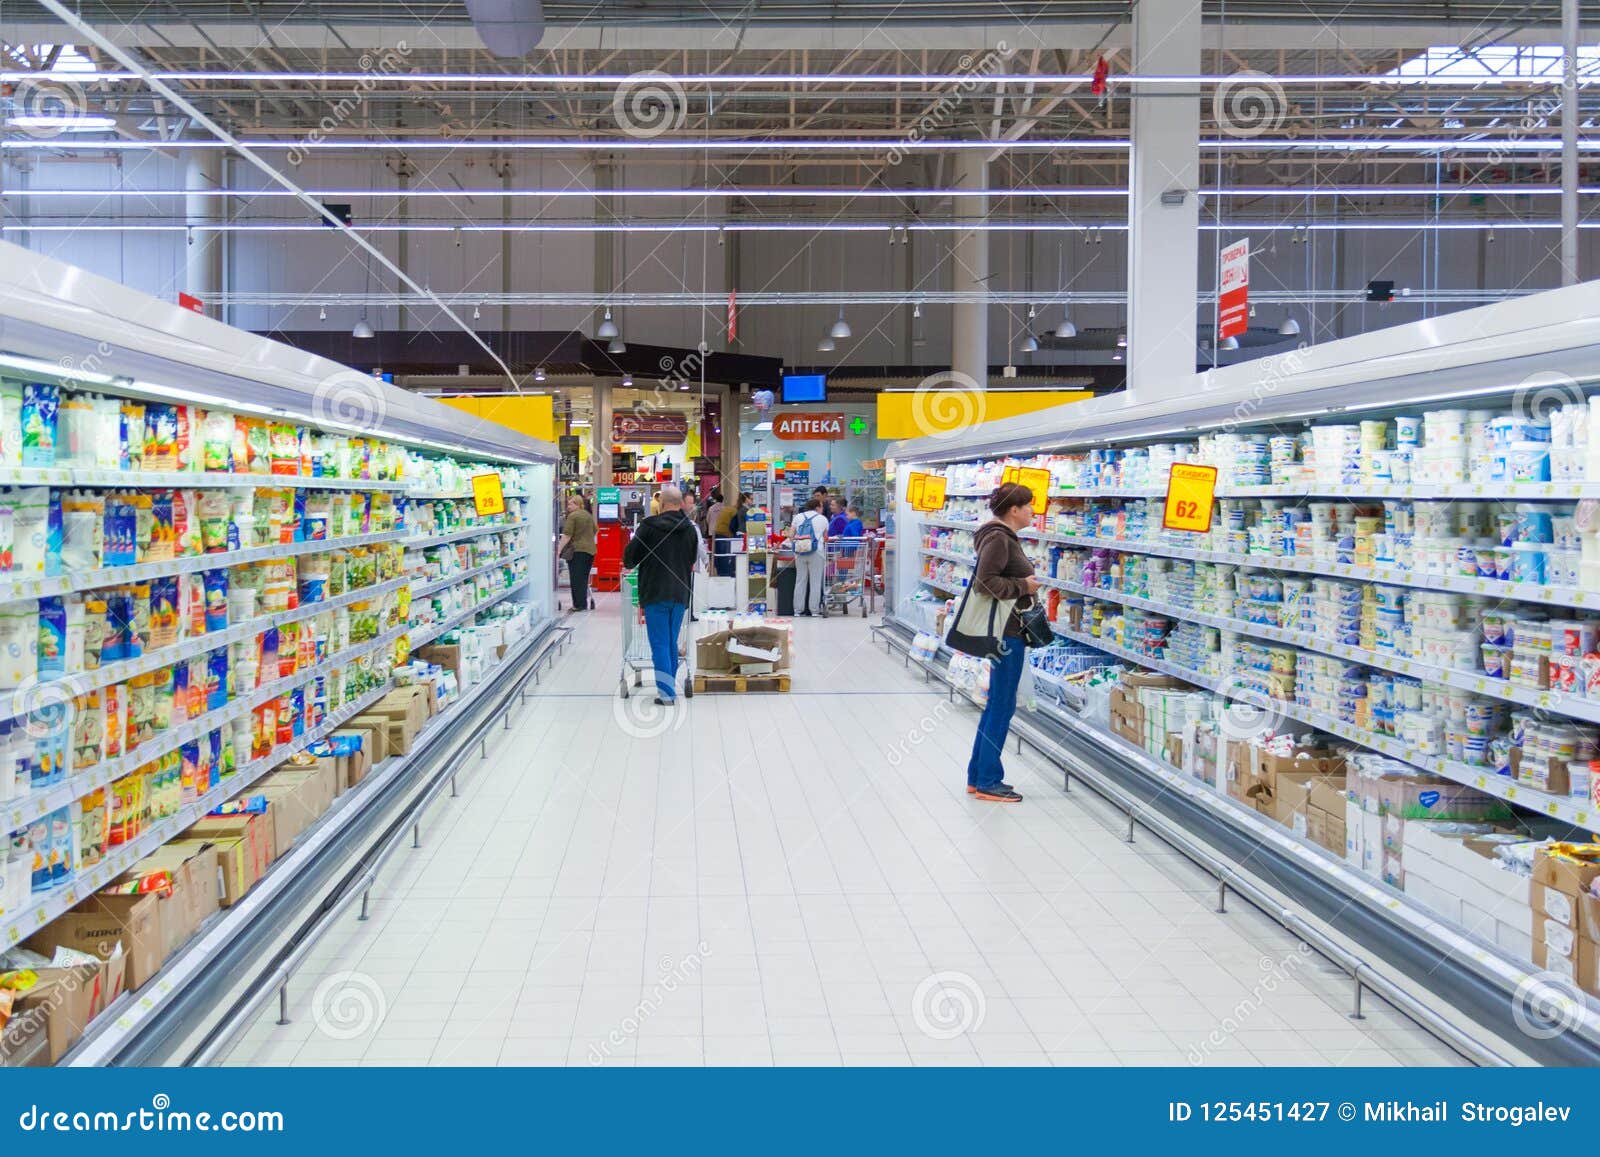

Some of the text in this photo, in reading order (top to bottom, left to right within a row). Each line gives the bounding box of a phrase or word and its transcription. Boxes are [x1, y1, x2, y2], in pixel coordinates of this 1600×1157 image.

[779, 420, 841, 433] АПТЕКА
[630, 491, 637, 500] 6
[1175, 500, 1198, 519] 62
